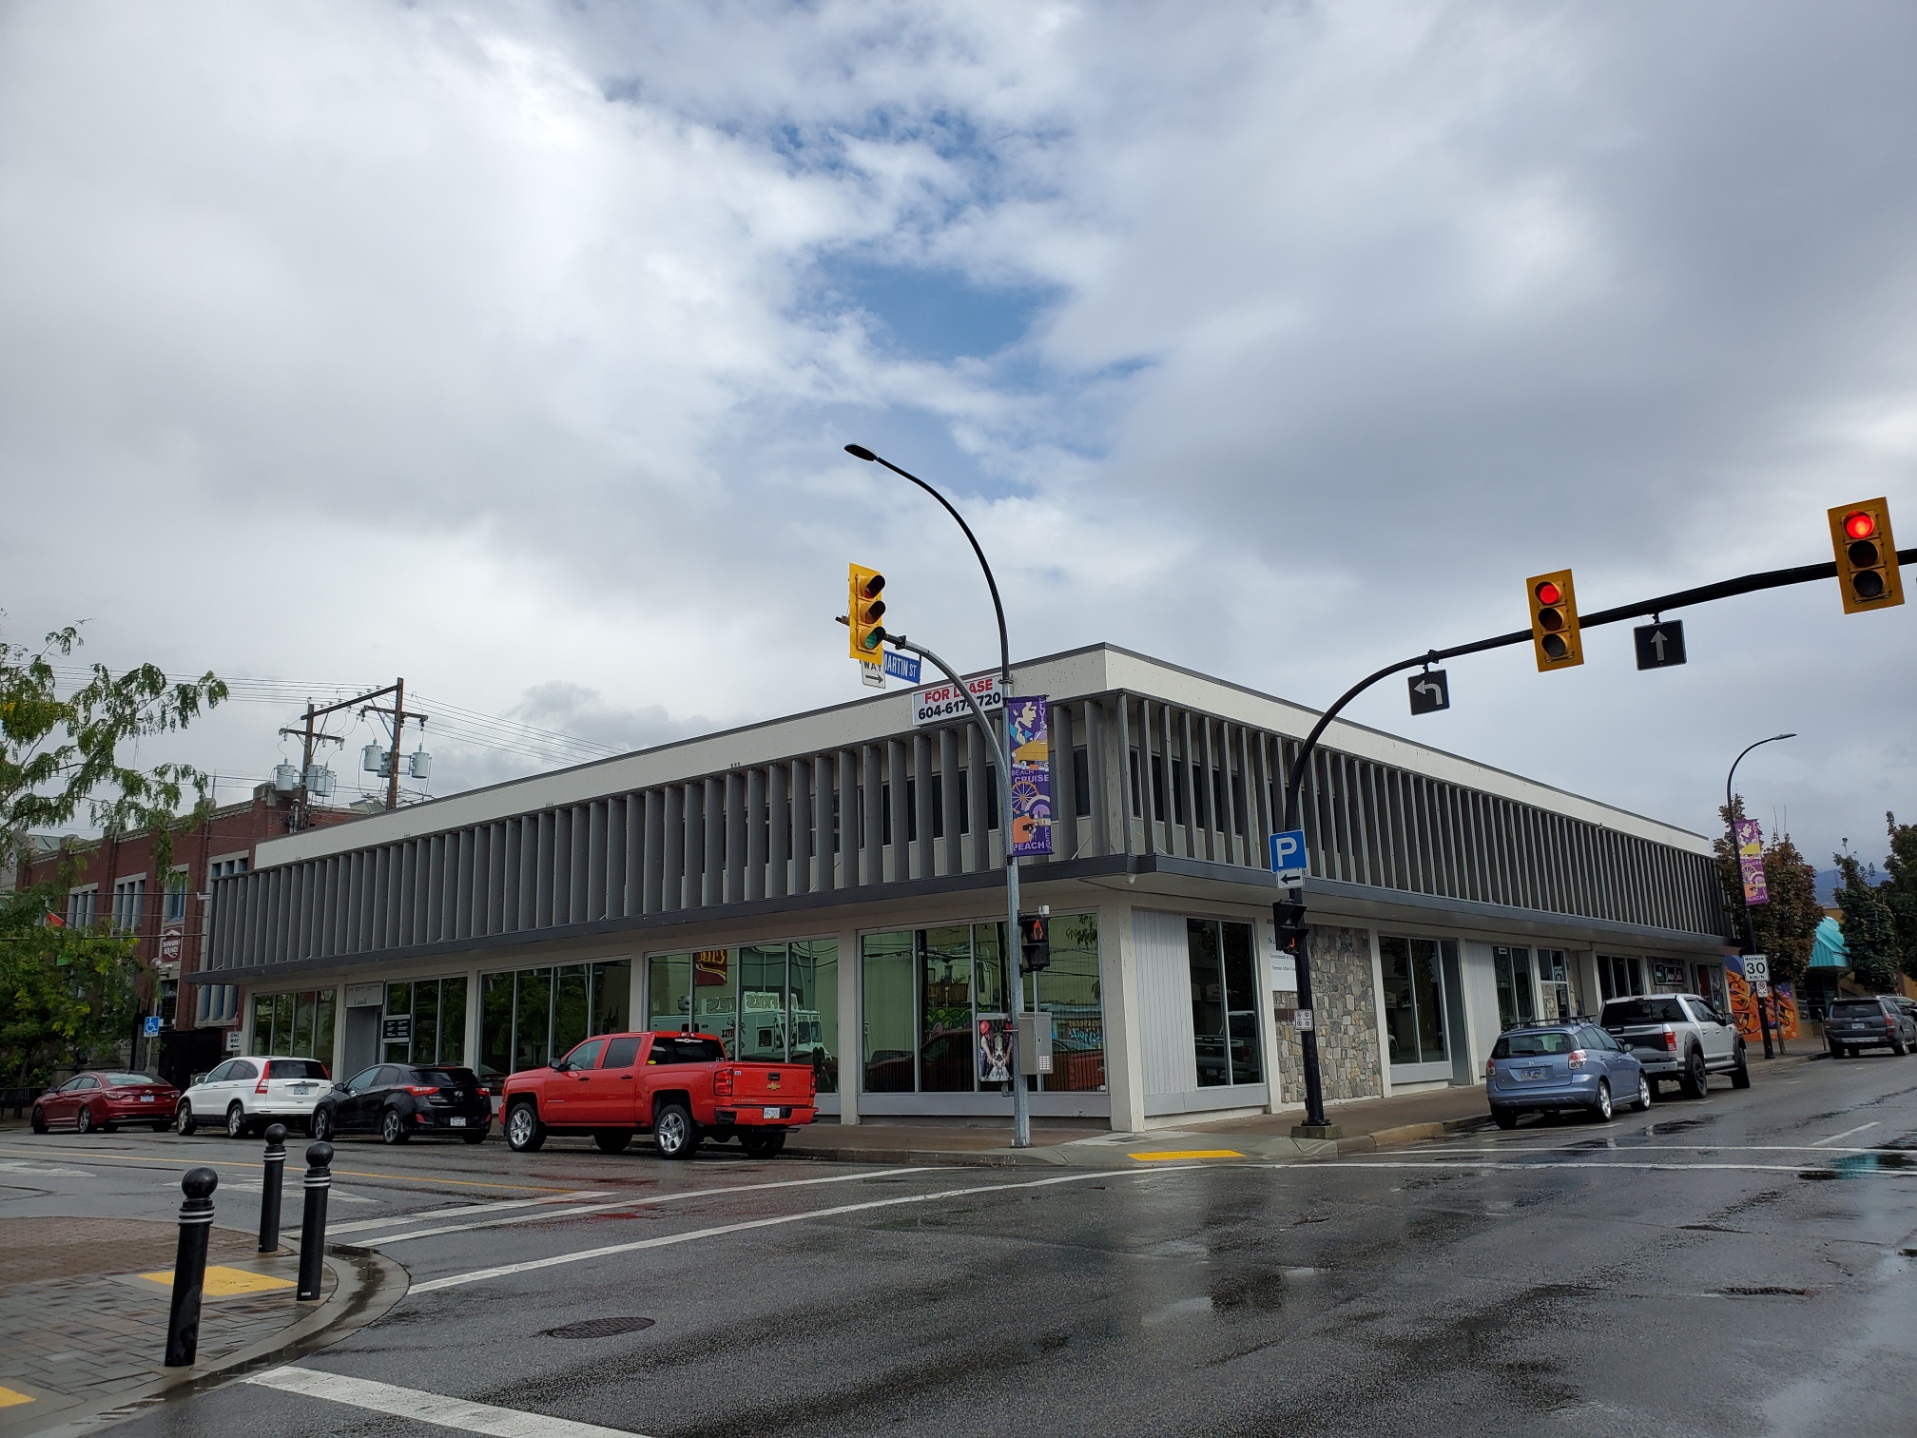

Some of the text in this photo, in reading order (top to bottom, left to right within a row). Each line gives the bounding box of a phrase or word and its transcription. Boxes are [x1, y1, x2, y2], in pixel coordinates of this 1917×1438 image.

[909, 663, 918, 678] ST
[924, 678, 993, 704] FOR LASE
[918, 692, 1001, 720] 604-617-720
[1015, 774, 1049, 783] CRUISE
[1276, 837, 1297, 867] P
[1746, 962, 1765, 974] 30
